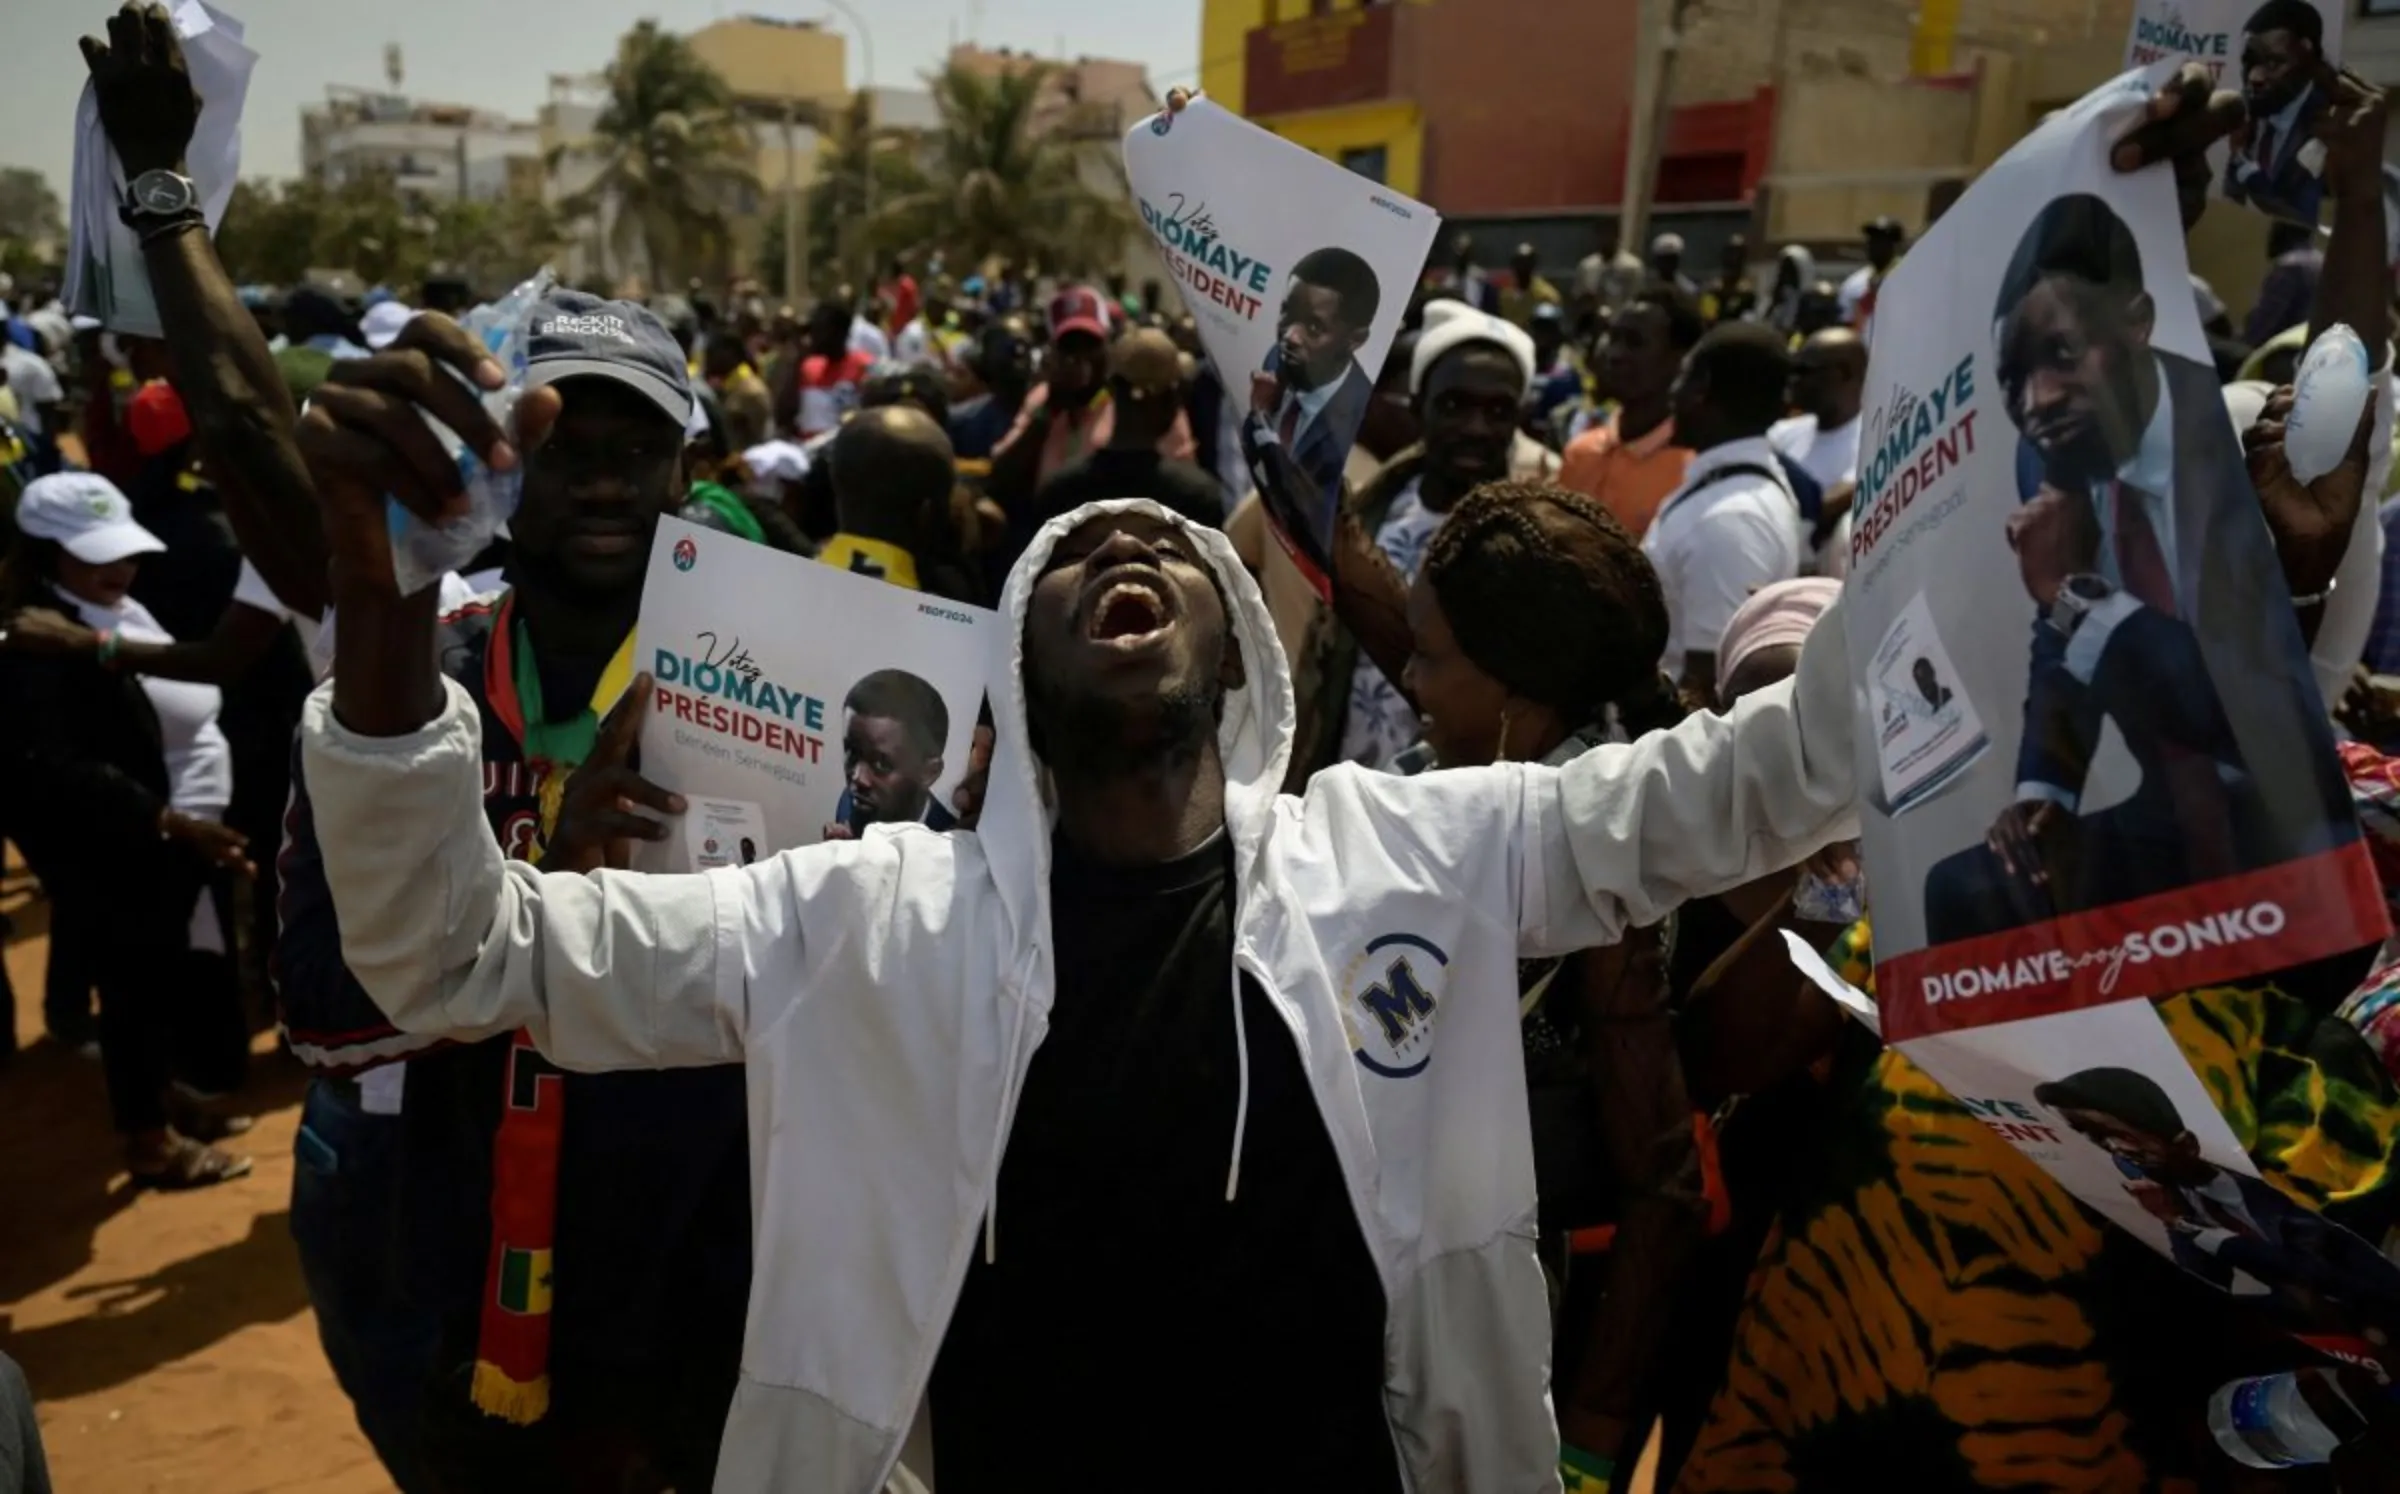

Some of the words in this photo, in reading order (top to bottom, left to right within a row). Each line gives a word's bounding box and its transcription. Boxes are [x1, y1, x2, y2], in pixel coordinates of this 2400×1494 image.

[2136, 16, 2230, 56] DIOMAYE
[1139, 196, 1272, 294] DIOMAYE
[1852, 353, 1974, 523] DIOMAYE
[655, 648, 825, 731] DIOMAYE
[697, 631, 763, 684] Votez
[656, 687, 825, 765] PRÉSIDENT
[1921, 948, 2069, 1005] DIOMAYE
[2123, 902, 2286, 964] SONKO
[1357, 954, 1438, 1049] M
